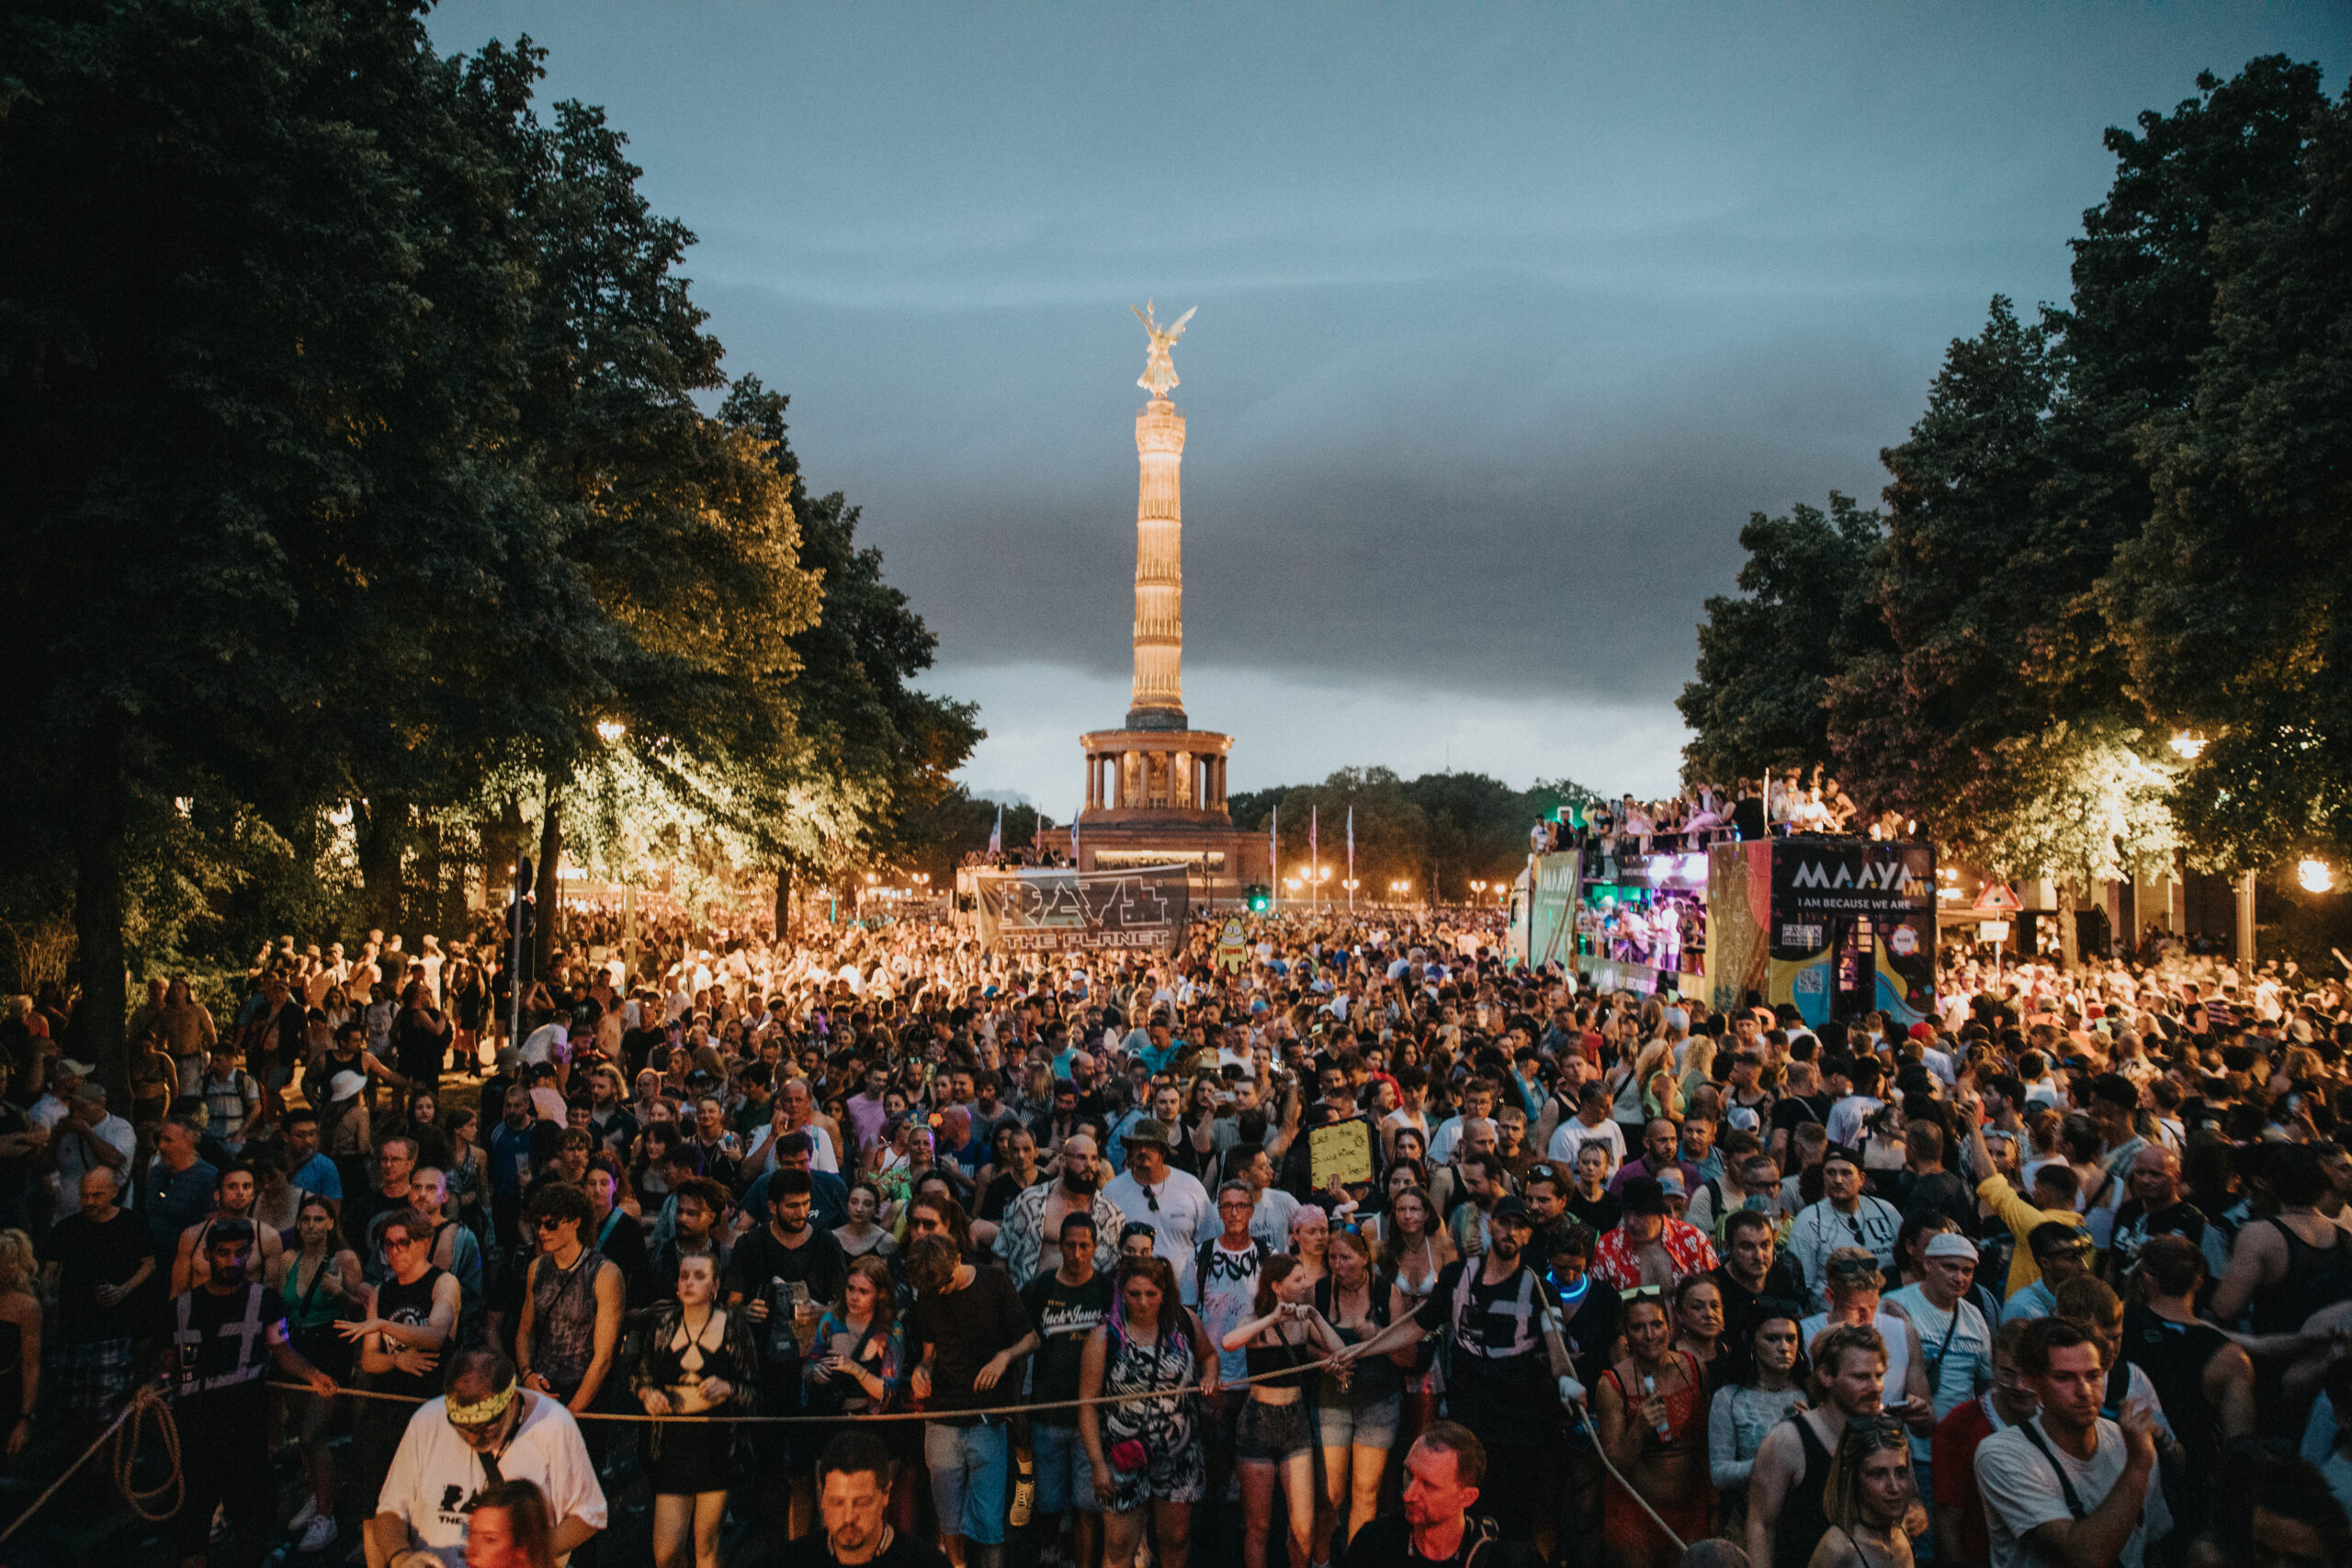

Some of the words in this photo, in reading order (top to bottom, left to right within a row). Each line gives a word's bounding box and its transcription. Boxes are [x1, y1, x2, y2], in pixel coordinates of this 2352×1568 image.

[1792, 860, 1914, 890] MAAYA
[998, 876, 1170, 931] RAVE
[1804, 897, 1820, 908] AM
[1823, 898, 1870, 909] BECAUSE
[1871, 899, 1888, 909] WE
[1890, 900, 1911, 910] ARE
[1003, 933, 1057, 949] THE
[1062, 931, 1170, 948] PLANET
